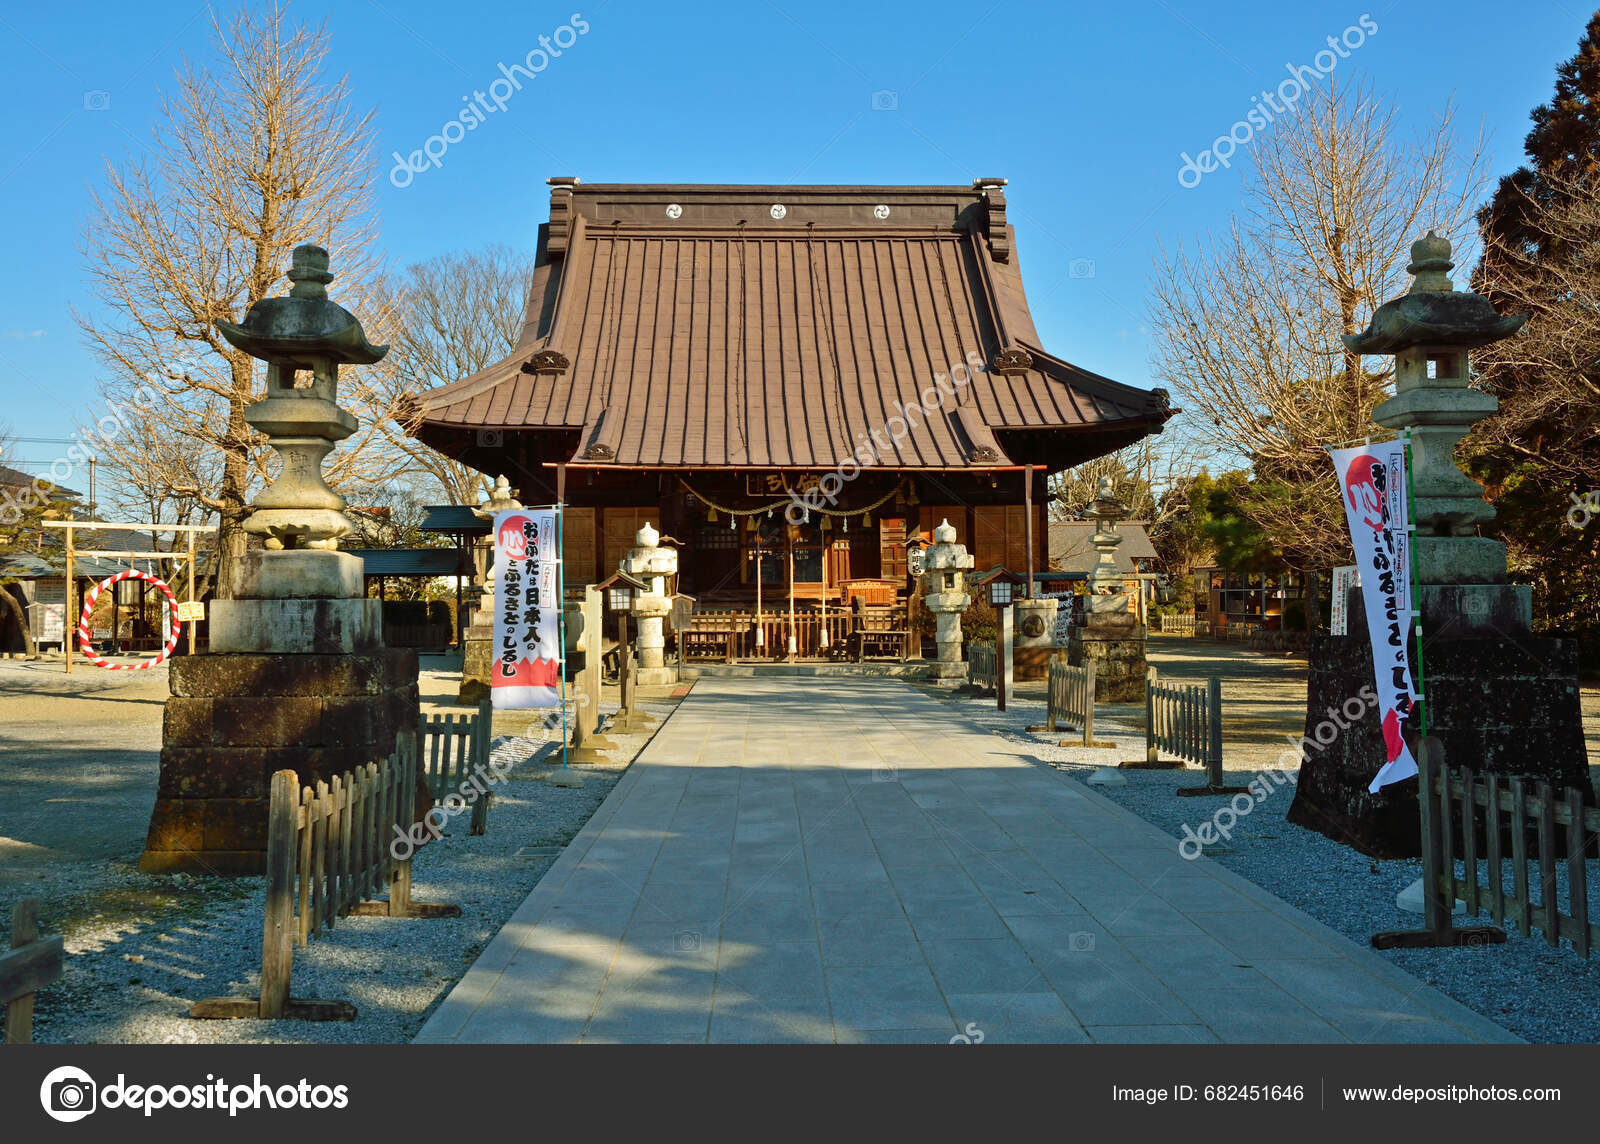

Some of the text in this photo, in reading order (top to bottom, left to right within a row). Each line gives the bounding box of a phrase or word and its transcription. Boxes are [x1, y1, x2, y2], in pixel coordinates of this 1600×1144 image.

[523, 521, 541, 650] おふだは日本人の
